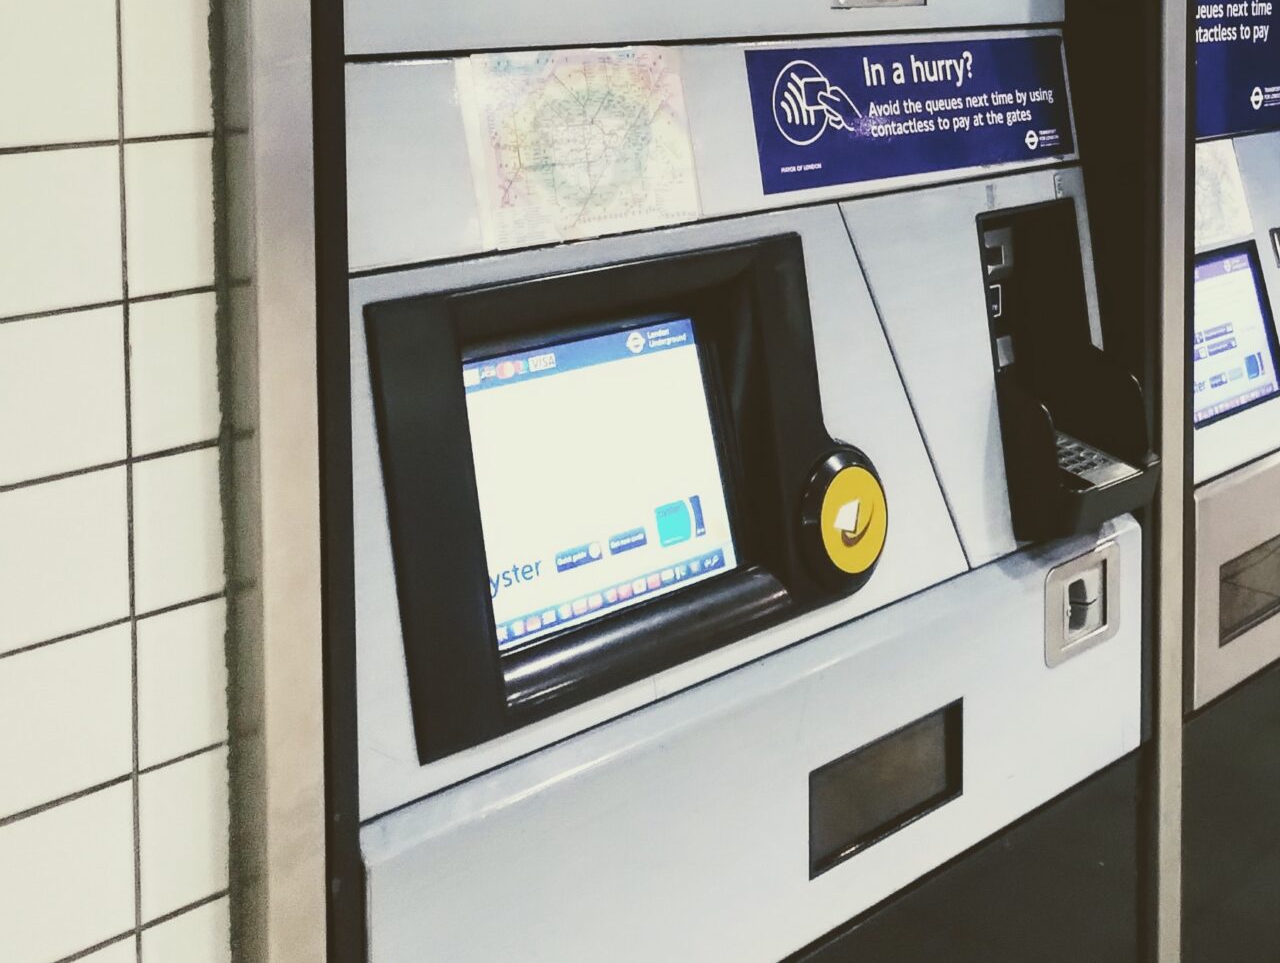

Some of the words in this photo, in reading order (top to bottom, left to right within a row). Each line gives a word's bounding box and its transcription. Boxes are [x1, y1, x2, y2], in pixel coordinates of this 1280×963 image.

[1226, 0, 1248, 17] next
[1251, 0, 1272, 16] time
[1240, 23, 1250, 40] to
[1253, 24, 1269, 43] pay
[863, 56, 885, 86] In
[892, 61, 905, 85] a
[910, 51, 973, 87] hurry?
[868, 100, 900, 118] Avoid
[903, 99, 922, 114] the
[925, 98, 963, 115] queues
[966, 93, 989, 108] next
[991, 92, 1014, 106] time
[1015, 90, 1027, 106] by
[1029, 88, 1054, 104] using
[870, 118, 935, 138] contactless
[937, 117, 950, 130] to
[953, 116, 970, 132] pay
[973, 113, 984, 126] at
[986, 111, 1004, 125] the
[1006, 108, 1032, 126] gates
[532, 355, 555, 369] VISA
